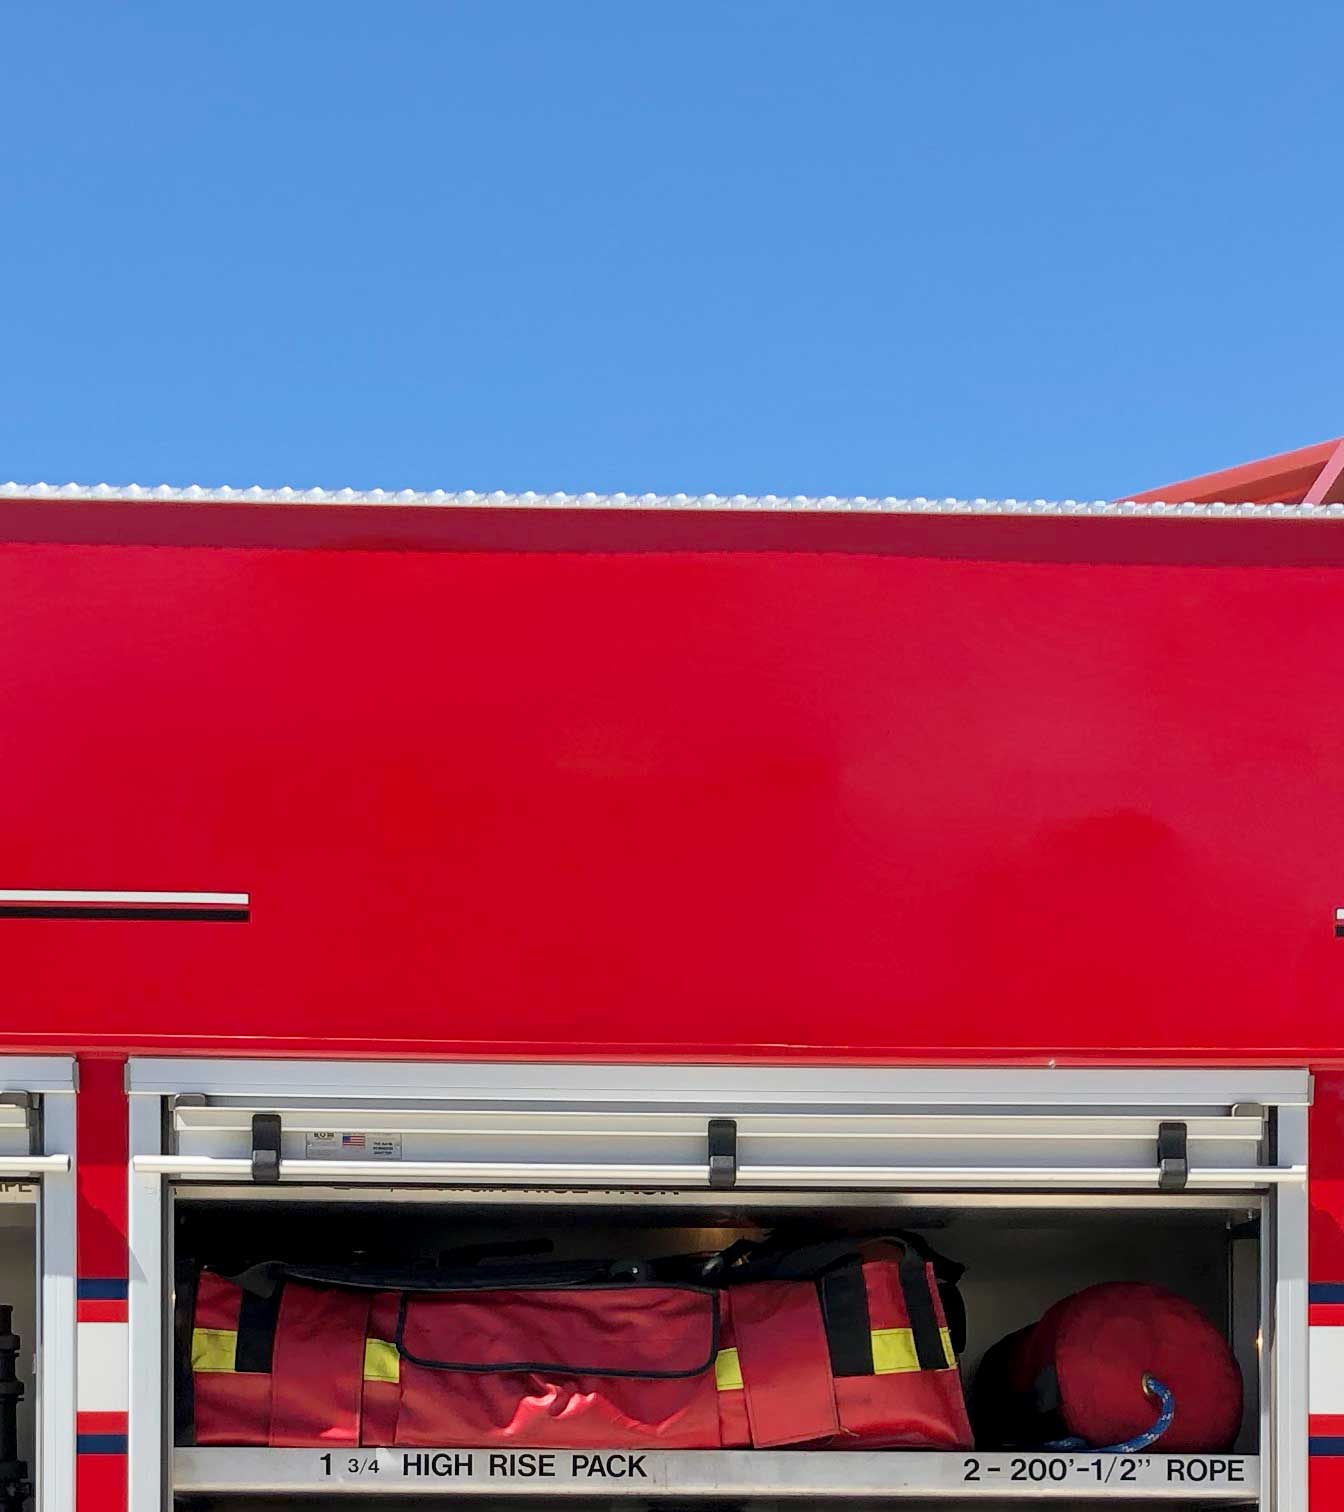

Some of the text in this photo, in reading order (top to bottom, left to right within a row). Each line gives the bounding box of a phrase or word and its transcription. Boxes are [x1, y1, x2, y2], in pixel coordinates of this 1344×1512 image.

[320, 1453, 648, 1478] 1 3/4 HIGH RISE PACK
[963, 1458, 981, 1481] 2
[1167, 1458, 1245, 1482] ROPE
